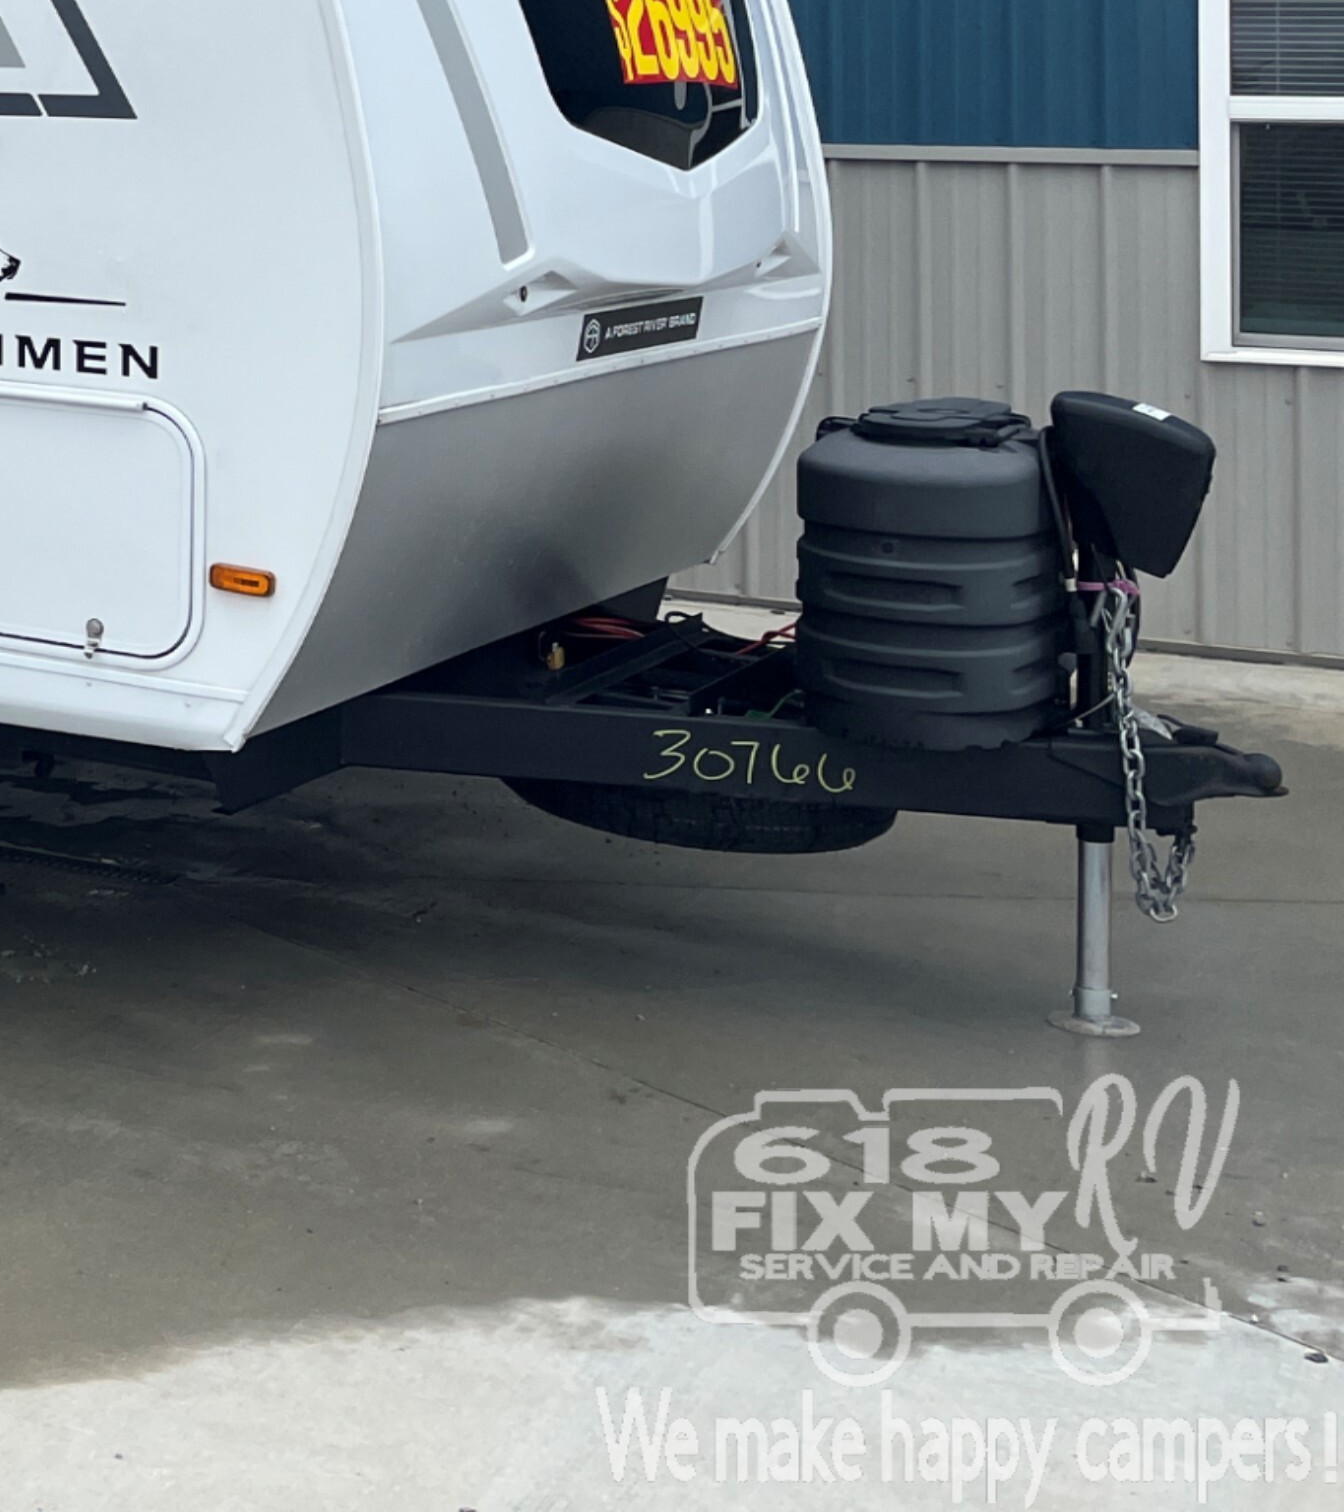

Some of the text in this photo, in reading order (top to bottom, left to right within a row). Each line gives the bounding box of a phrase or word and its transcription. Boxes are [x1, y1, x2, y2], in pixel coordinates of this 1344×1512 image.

[613, 320, 644, 338] FOREST
[643, 316, 668, 332] RIVER
[642, 728, 857, 794] 30766
